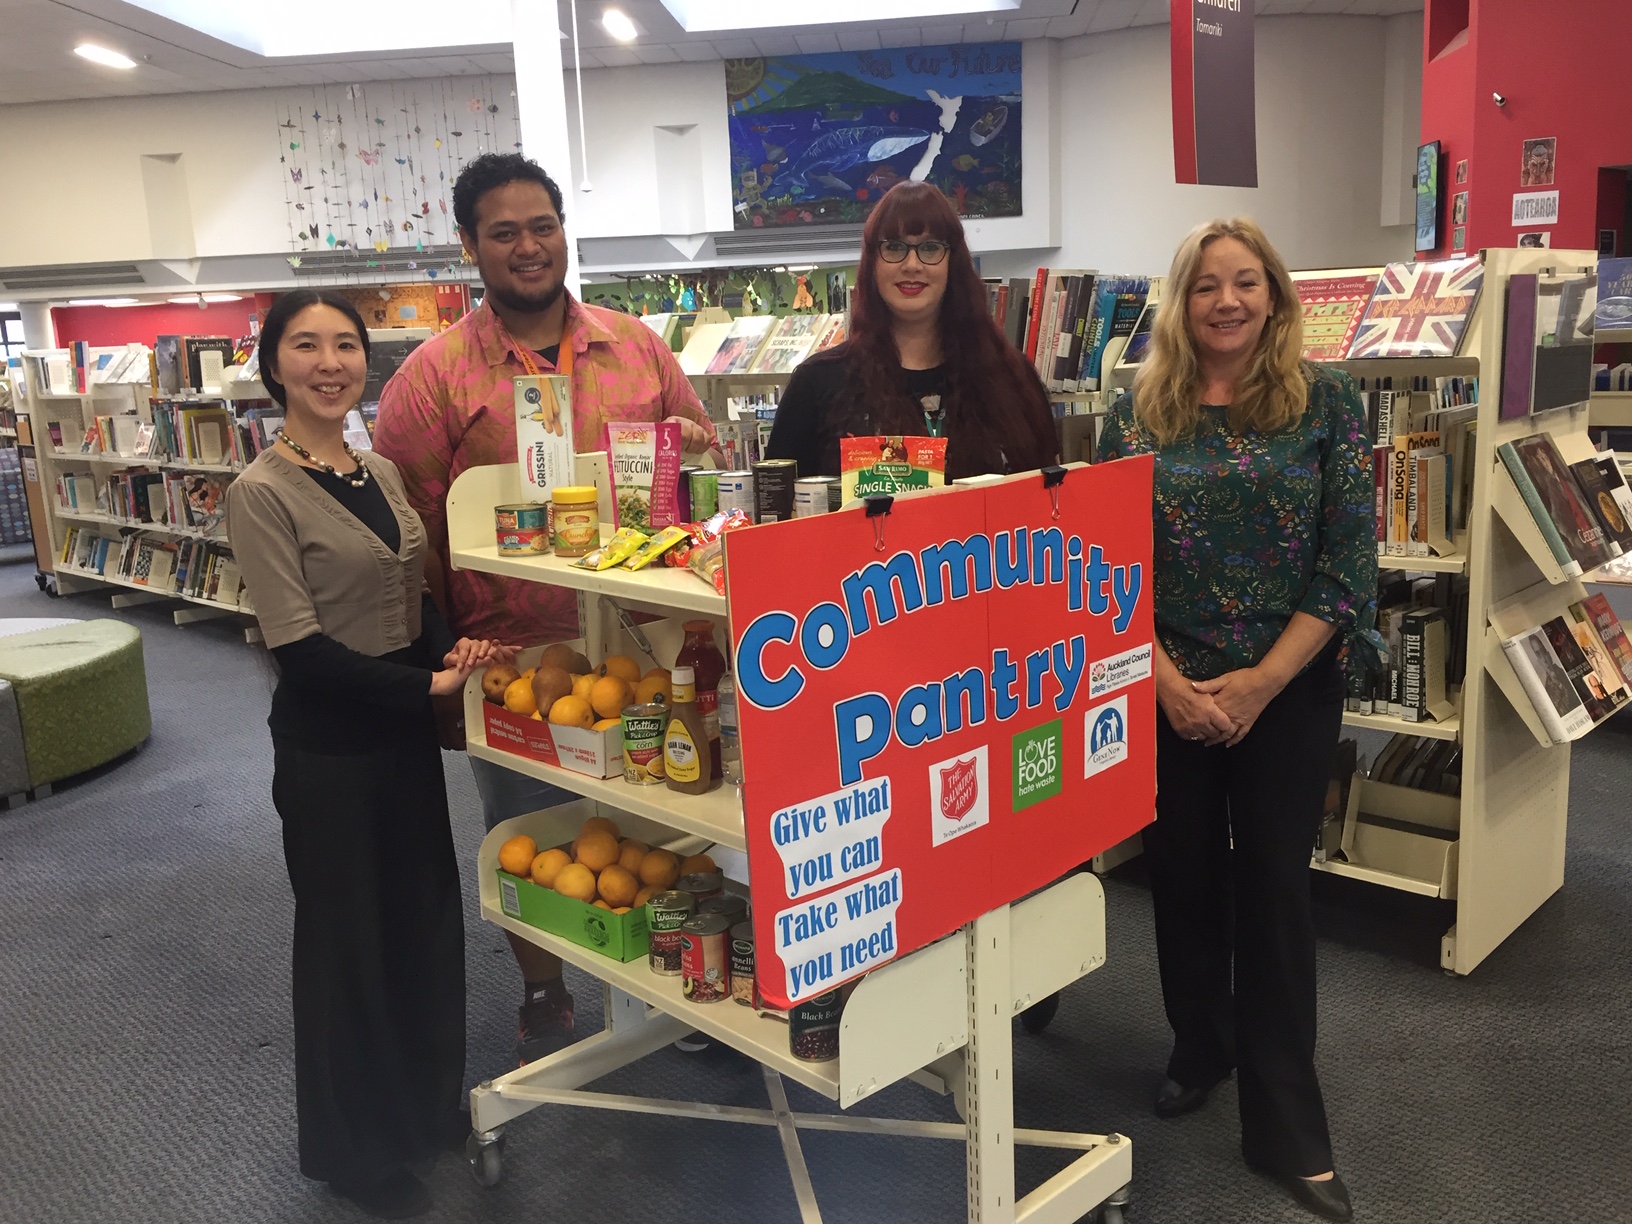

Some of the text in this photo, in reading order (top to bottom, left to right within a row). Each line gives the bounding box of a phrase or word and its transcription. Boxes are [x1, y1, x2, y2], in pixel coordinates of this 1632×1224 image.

[1197, 0, 1241, 12] dren
[1196, 18, 1223, 36] Tamariki
[1337, 282, 1366, 292] Coming
[1094, 317, 1105, 347] TOOLS
[1380, 392, 1389, 410] MAD
[662, 430, 672, 450] 5
[1378, 422, 1387, 440] HELL
[535, 441, 547, 488] GRISSINI
[1395, 450, 1406, 500] OnSong
[854, 481, 893, 498] SINGLE
[1408, 456, 1417, 512] TIMBALAND
[736, 526, 1143, 711] Community
[1107, 649, 1151, 672] Auckland Council
[1406, 634, 1420, 707] BILL MONROE
[1107, 669, 1130, 683] Libraries
[628, 721, 660, 731] Wattie's
[833, 634, 1087, 788] Pantry
[1018, 735, 1056, 767] LOVE
[948, 767, 962, 789] THE
[1018, 755, 1056, 785] FOOD
[943, 764, 976, 811] SALVATION
[954, 781, 974, 815] ARMY
[1018, 774, 1056, 797] hate waste
[774, 779, 889, 847] Give what
[789, 835, 880, 898] you can
[778, 871, 899, 948] Take what
[790, 921, 895, 998] you need
[801, 1011, 824, 1021] Black
